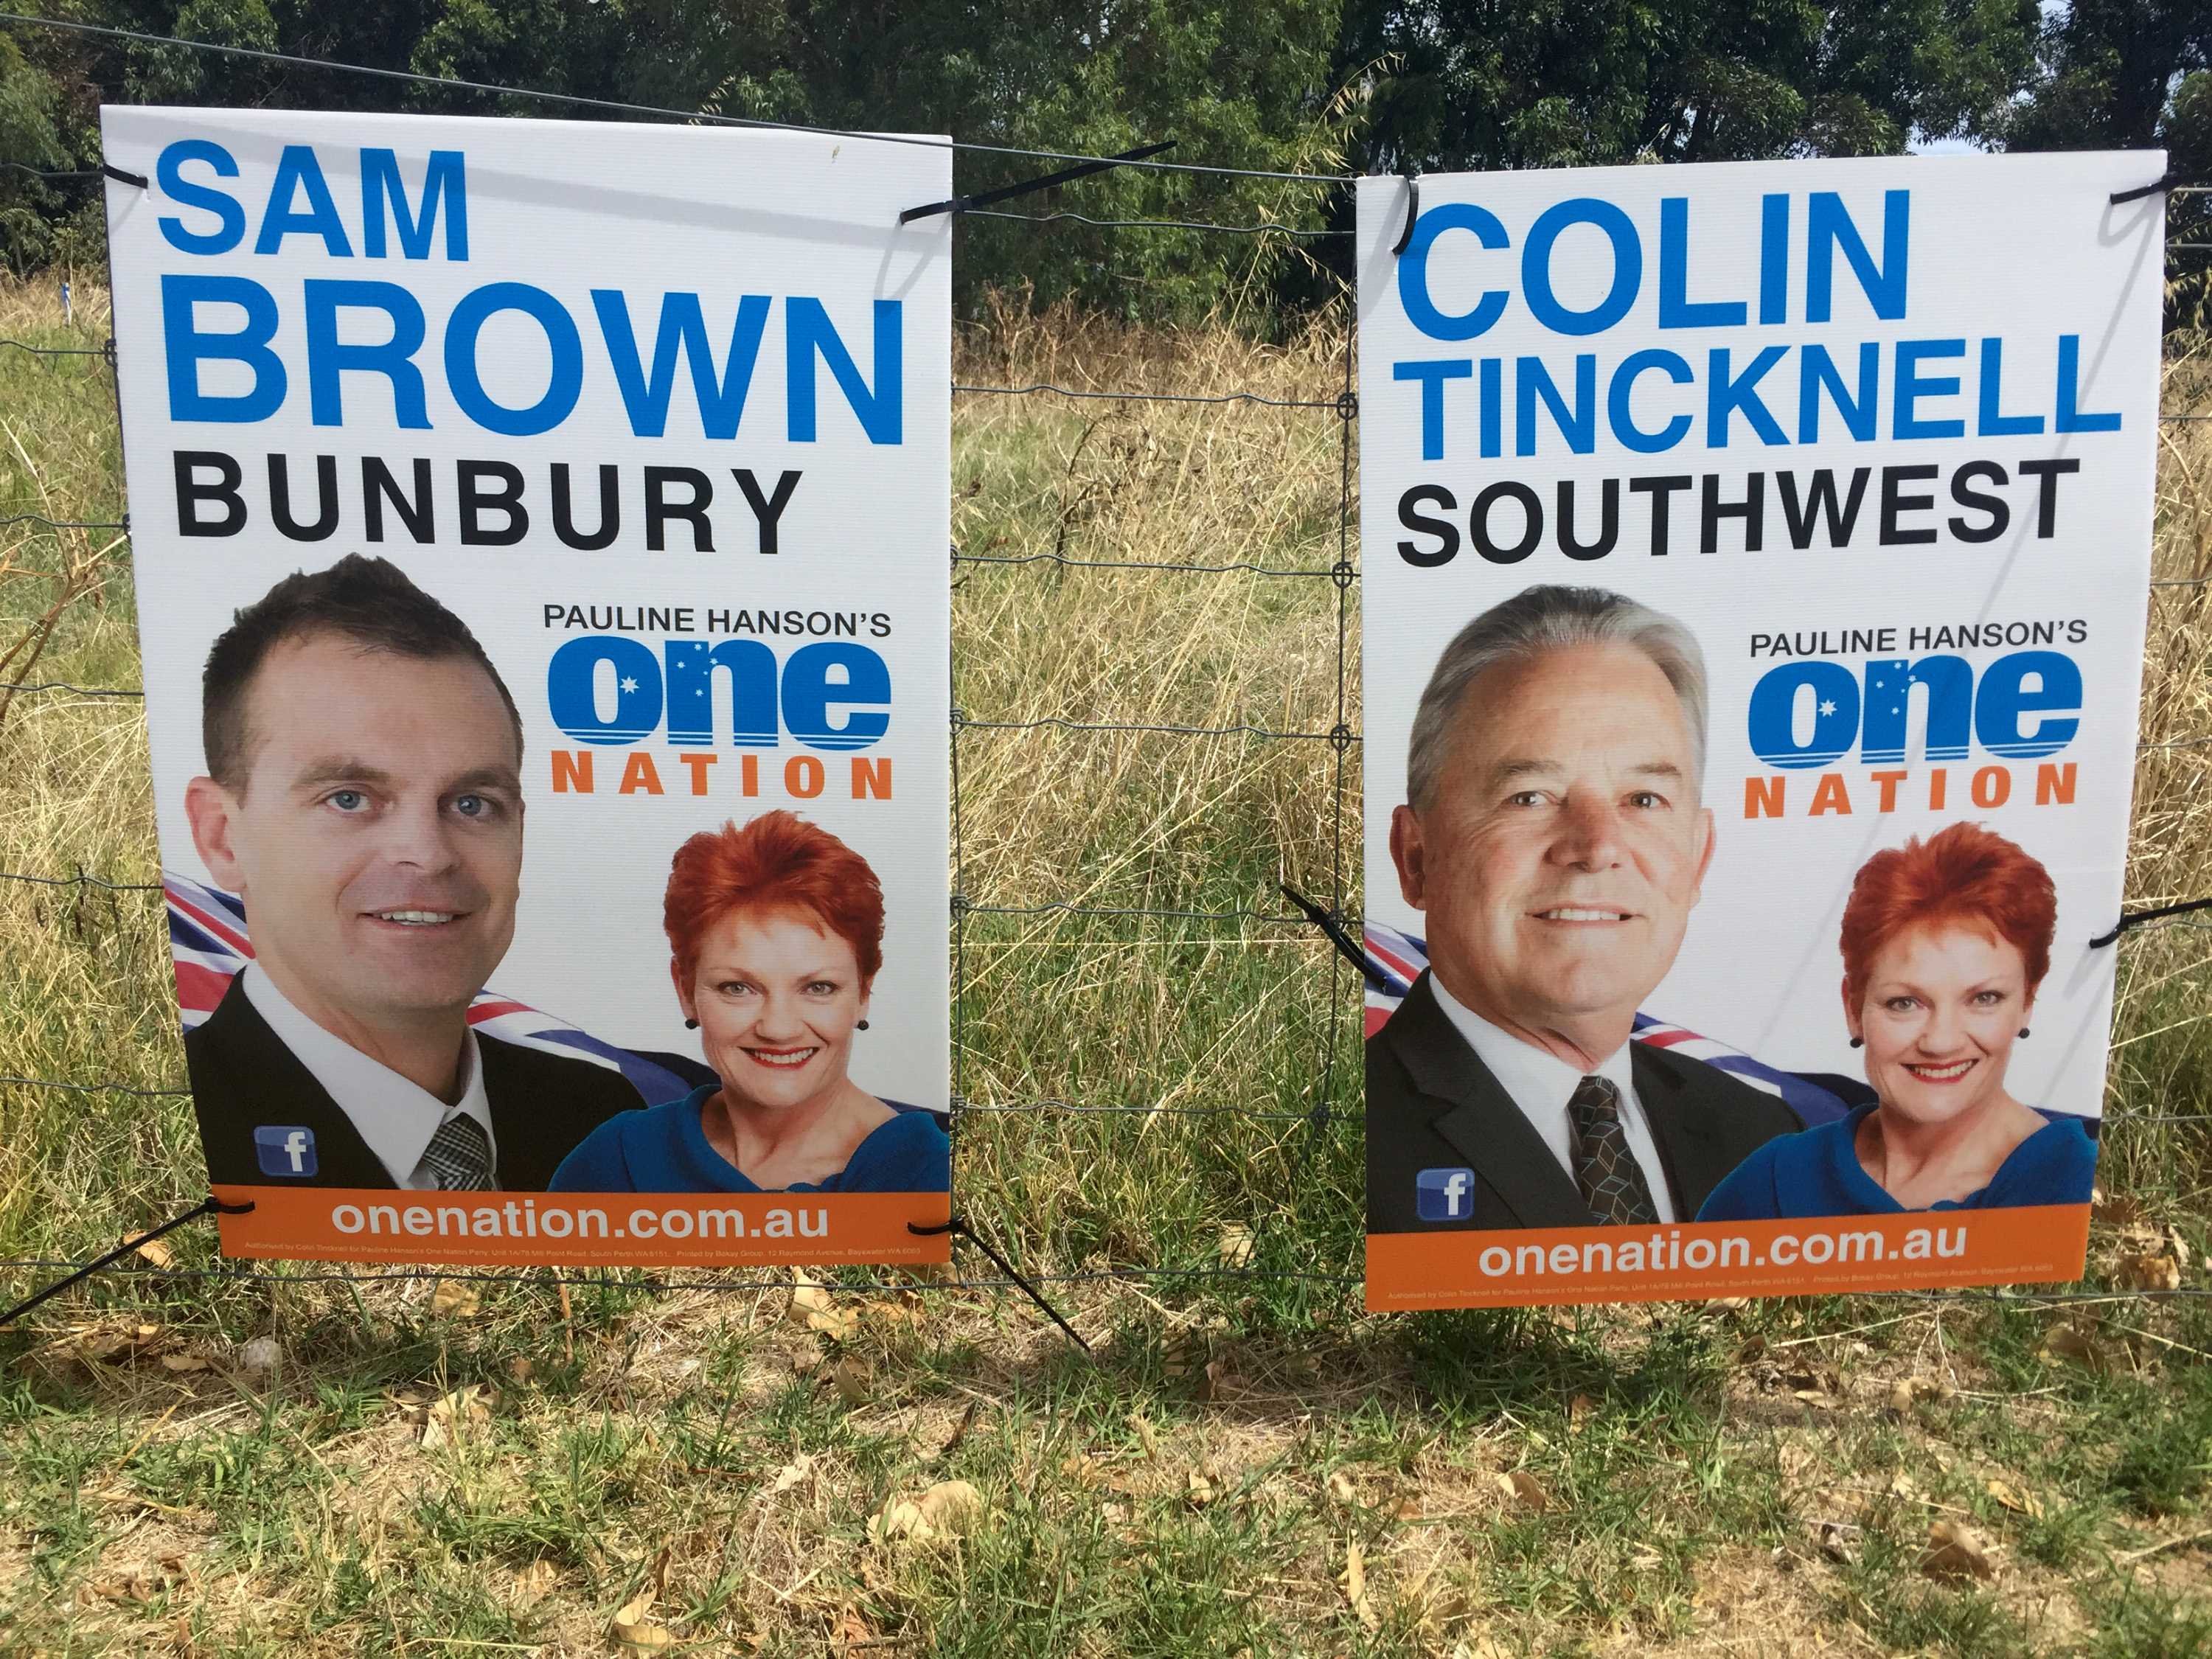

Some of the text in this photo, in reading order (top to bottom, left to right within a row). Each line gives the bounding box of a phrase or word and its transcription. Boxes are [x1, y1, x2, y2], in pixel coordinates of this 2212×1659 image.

[156, 139, 469, 261] SAM
[1397, 189, 1910, 341] COLIN
[161, 274, 902, 446] BROWN
[1393, 335, 2122, 461] TINCKNELL
[173, 450, 803, 555] BUNBURY
[1397, 459, 2080, 567] SOUTHWEST
[543, 604, 892, 638] PAULINE HANSON'S
[1750, 619, 2088, 658] PAULINE HANSON'S
[548, 635, 892, 751] one
[1747, 650, 2084, 769] one
[551, 750, 892, 801] NATION
[1744, 762, 2078, 819] NATION
[331, 1199, 828, 1239] onenation.com.au
[1479, 1226, 1966, 1277] onenation.com.au
